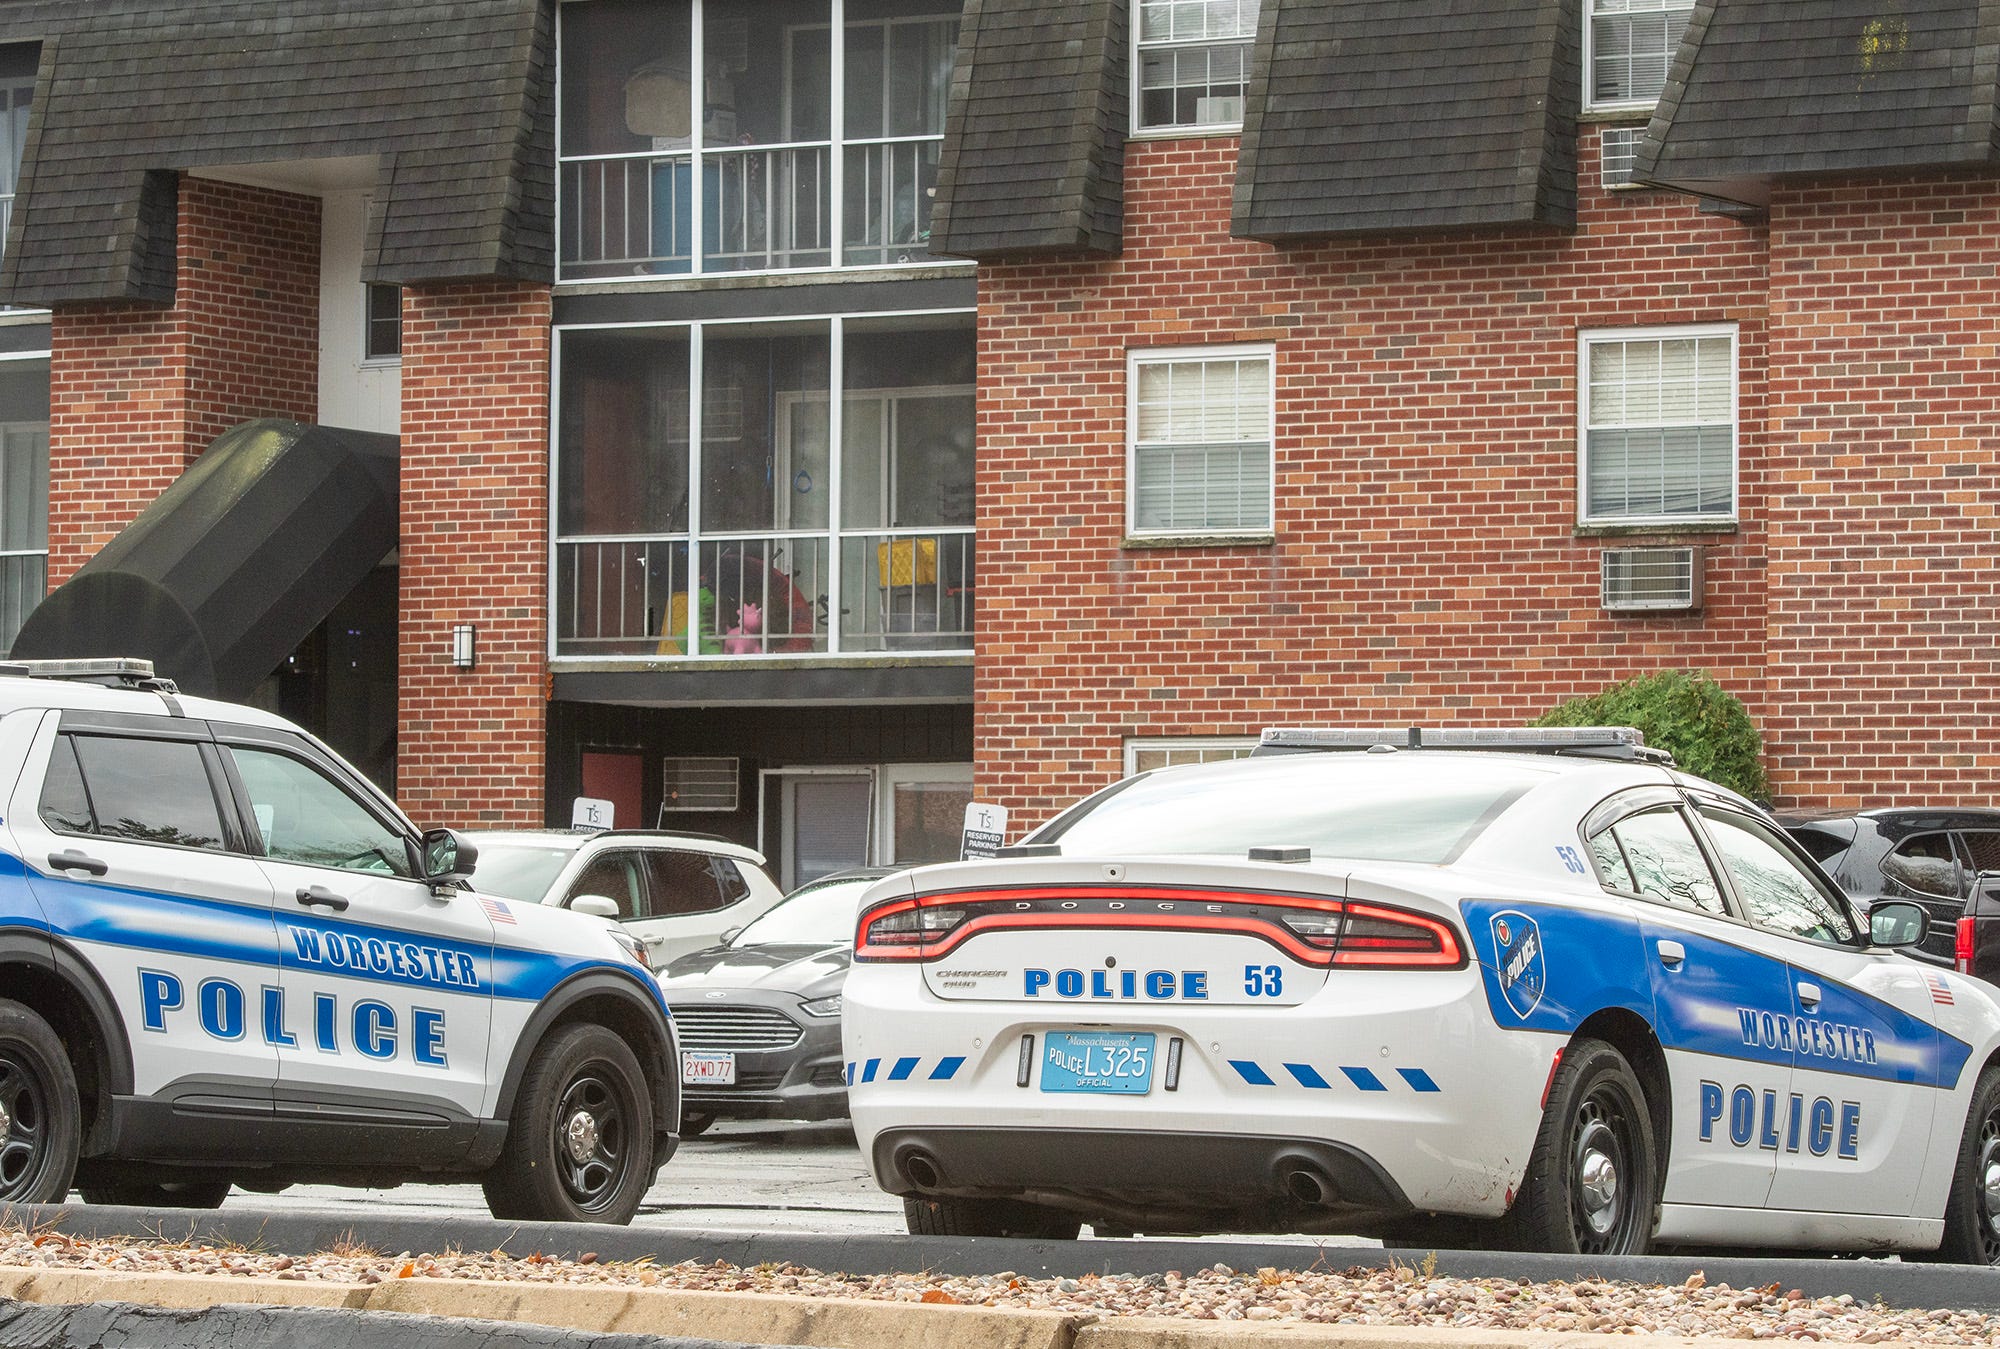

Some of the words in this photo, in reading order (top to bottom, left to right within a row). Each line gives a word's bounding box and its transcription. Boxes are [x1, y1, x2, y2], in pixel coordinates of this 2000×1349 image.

[966, 831, 1001, 841] RESERVED
[968, 840, 998, 849] PARKING
[1554, 846, 1585, 874] 53
[1015, 901, 1223, 913] DODGE
[288, 925, 480, 989] WORCESTER
[1507, 933, 1537, 989] POLICE
[1024, 968, 1209, 1000] POLICE
[1244, 965, 1283, 997] 53
[137, 966, 450, 1071] POLICE
[1068, 1036, 1130, 1047] Massachusetts
[1736, 1007, 1877, 1065] WORCESTER
[686, 1061, 715, 1077] 2XWD
[718, 1061, 731, 1077] 77
[1049, 1047, 1084, 1076] POLICE
[1084, 1047, 1149, 1078] L325
[1076, 1078, 1112, 1087] OFFICIAL
[1699, 1079, 1861, 1161] POLICE
